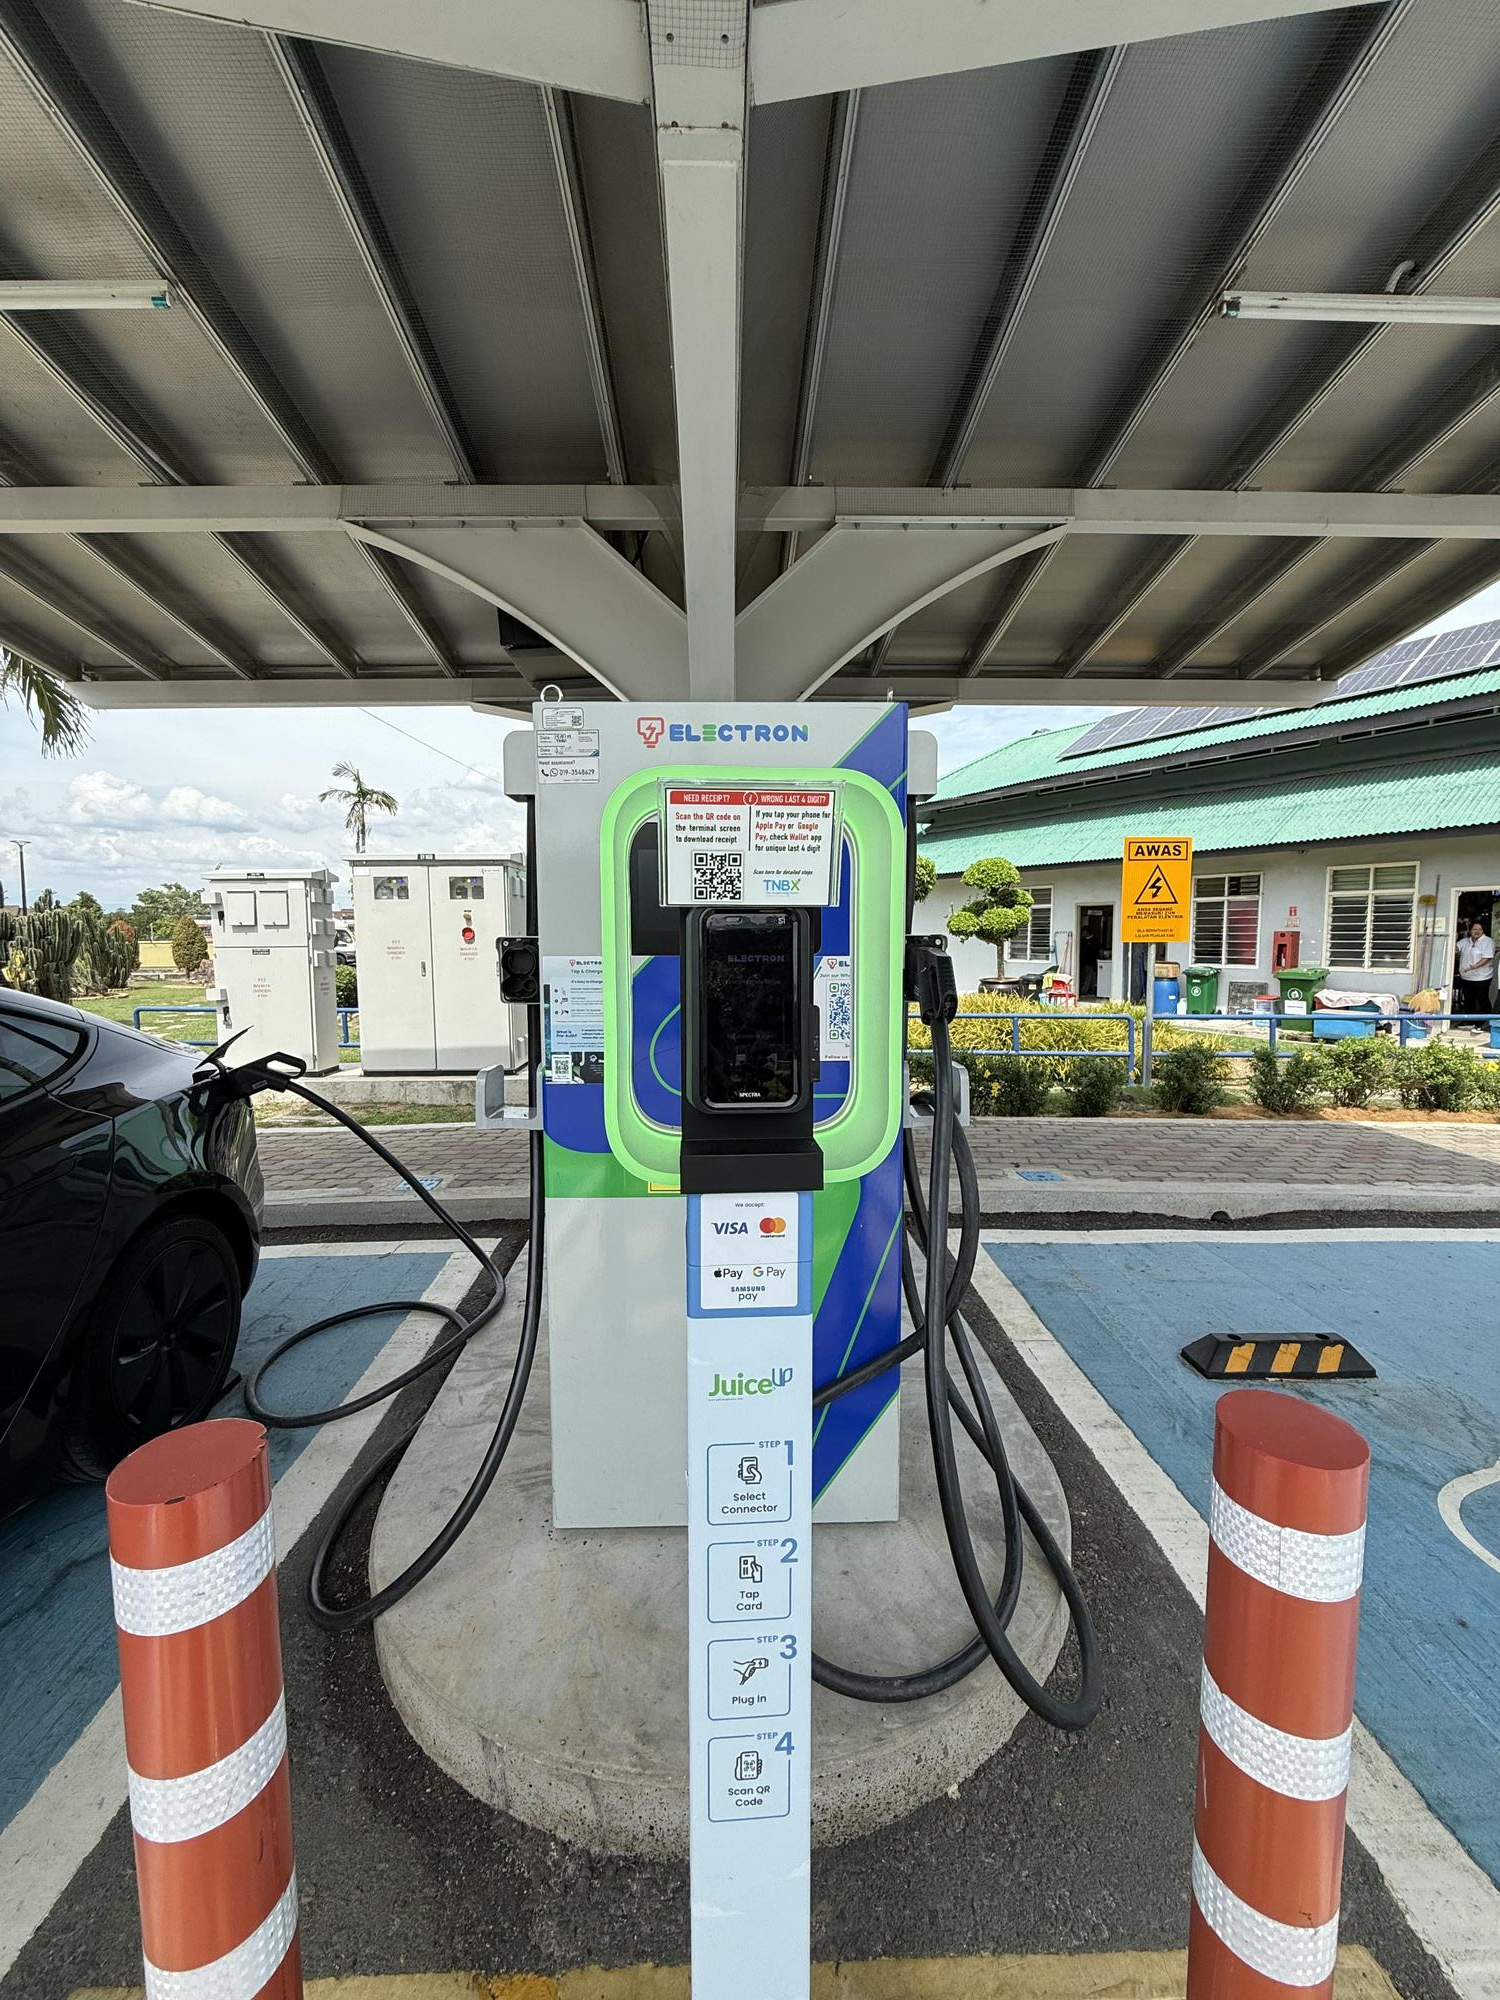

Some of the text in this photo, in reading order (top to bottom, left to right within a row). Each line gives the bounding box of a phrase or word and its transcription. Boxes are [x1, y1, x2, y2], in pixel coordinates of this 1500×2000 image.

[669, 724, 808, 742] ELECTRON
[684, 794, 730, 803] NEED RECEIPT?
[761, 795, 783, 803] WRONG
[785, 795, 800, 803] LAST
[807, 795, 826, 804] DIGIT?
[676, 812, 691, 820] Scan
[693, 812, 703, 820] the
[762, 811, 772, 819] you
[774, 811, 785, 819] tap
[786, 811, 799, 819] your
[801, 811, 820, 819] phone
[689, 824, 716, 832] terminal
[756, 822, 773, 831] Apple
[775, 822, 786, 831] Pay
[798, 822, 819, 831] Google
[684, 835, 714, 843] download
[715, 835, 737, 845] receipt
[755, 833, 768, 842] Pay,
[790, 833, 809, 841] Wallet
[766, 844, 786, 853] unique
[788, 844, 800, 852] last
[801, 844, 805, 852] 4
[807, 844, 820, 853] digit
[1134, 844, 1182, 856] AWAS
[763, 879, 801, 891] TNBX
[727, 954, 785, 962] ELECTRON
[711, 1222, 748, 1234] VISA
[723, 1268, 743, 1280] Pay
[752, 1266, 786, 1279] G Pay
[738, 1293, 758, 1302] pay
[758, 1440, 794, 1465] STEP 1
[733, 1492, 766, 1502] Select
[721, 1504, 778, 1514] Connector
[756, 1537, 798, 1563] STEP 2
[740, 1590, 760, 1600] Tap
[736, 1602, 762, 1611] Card
[756, 1634, 798, 1659] STEP 3
[732, 1695, 767, 1706] Plug In
[756, 1731, 795, 1755] STEP 4
[727, 1785, 770, 1796] Scan QR
[735, 1798, 763, 1807] Code
